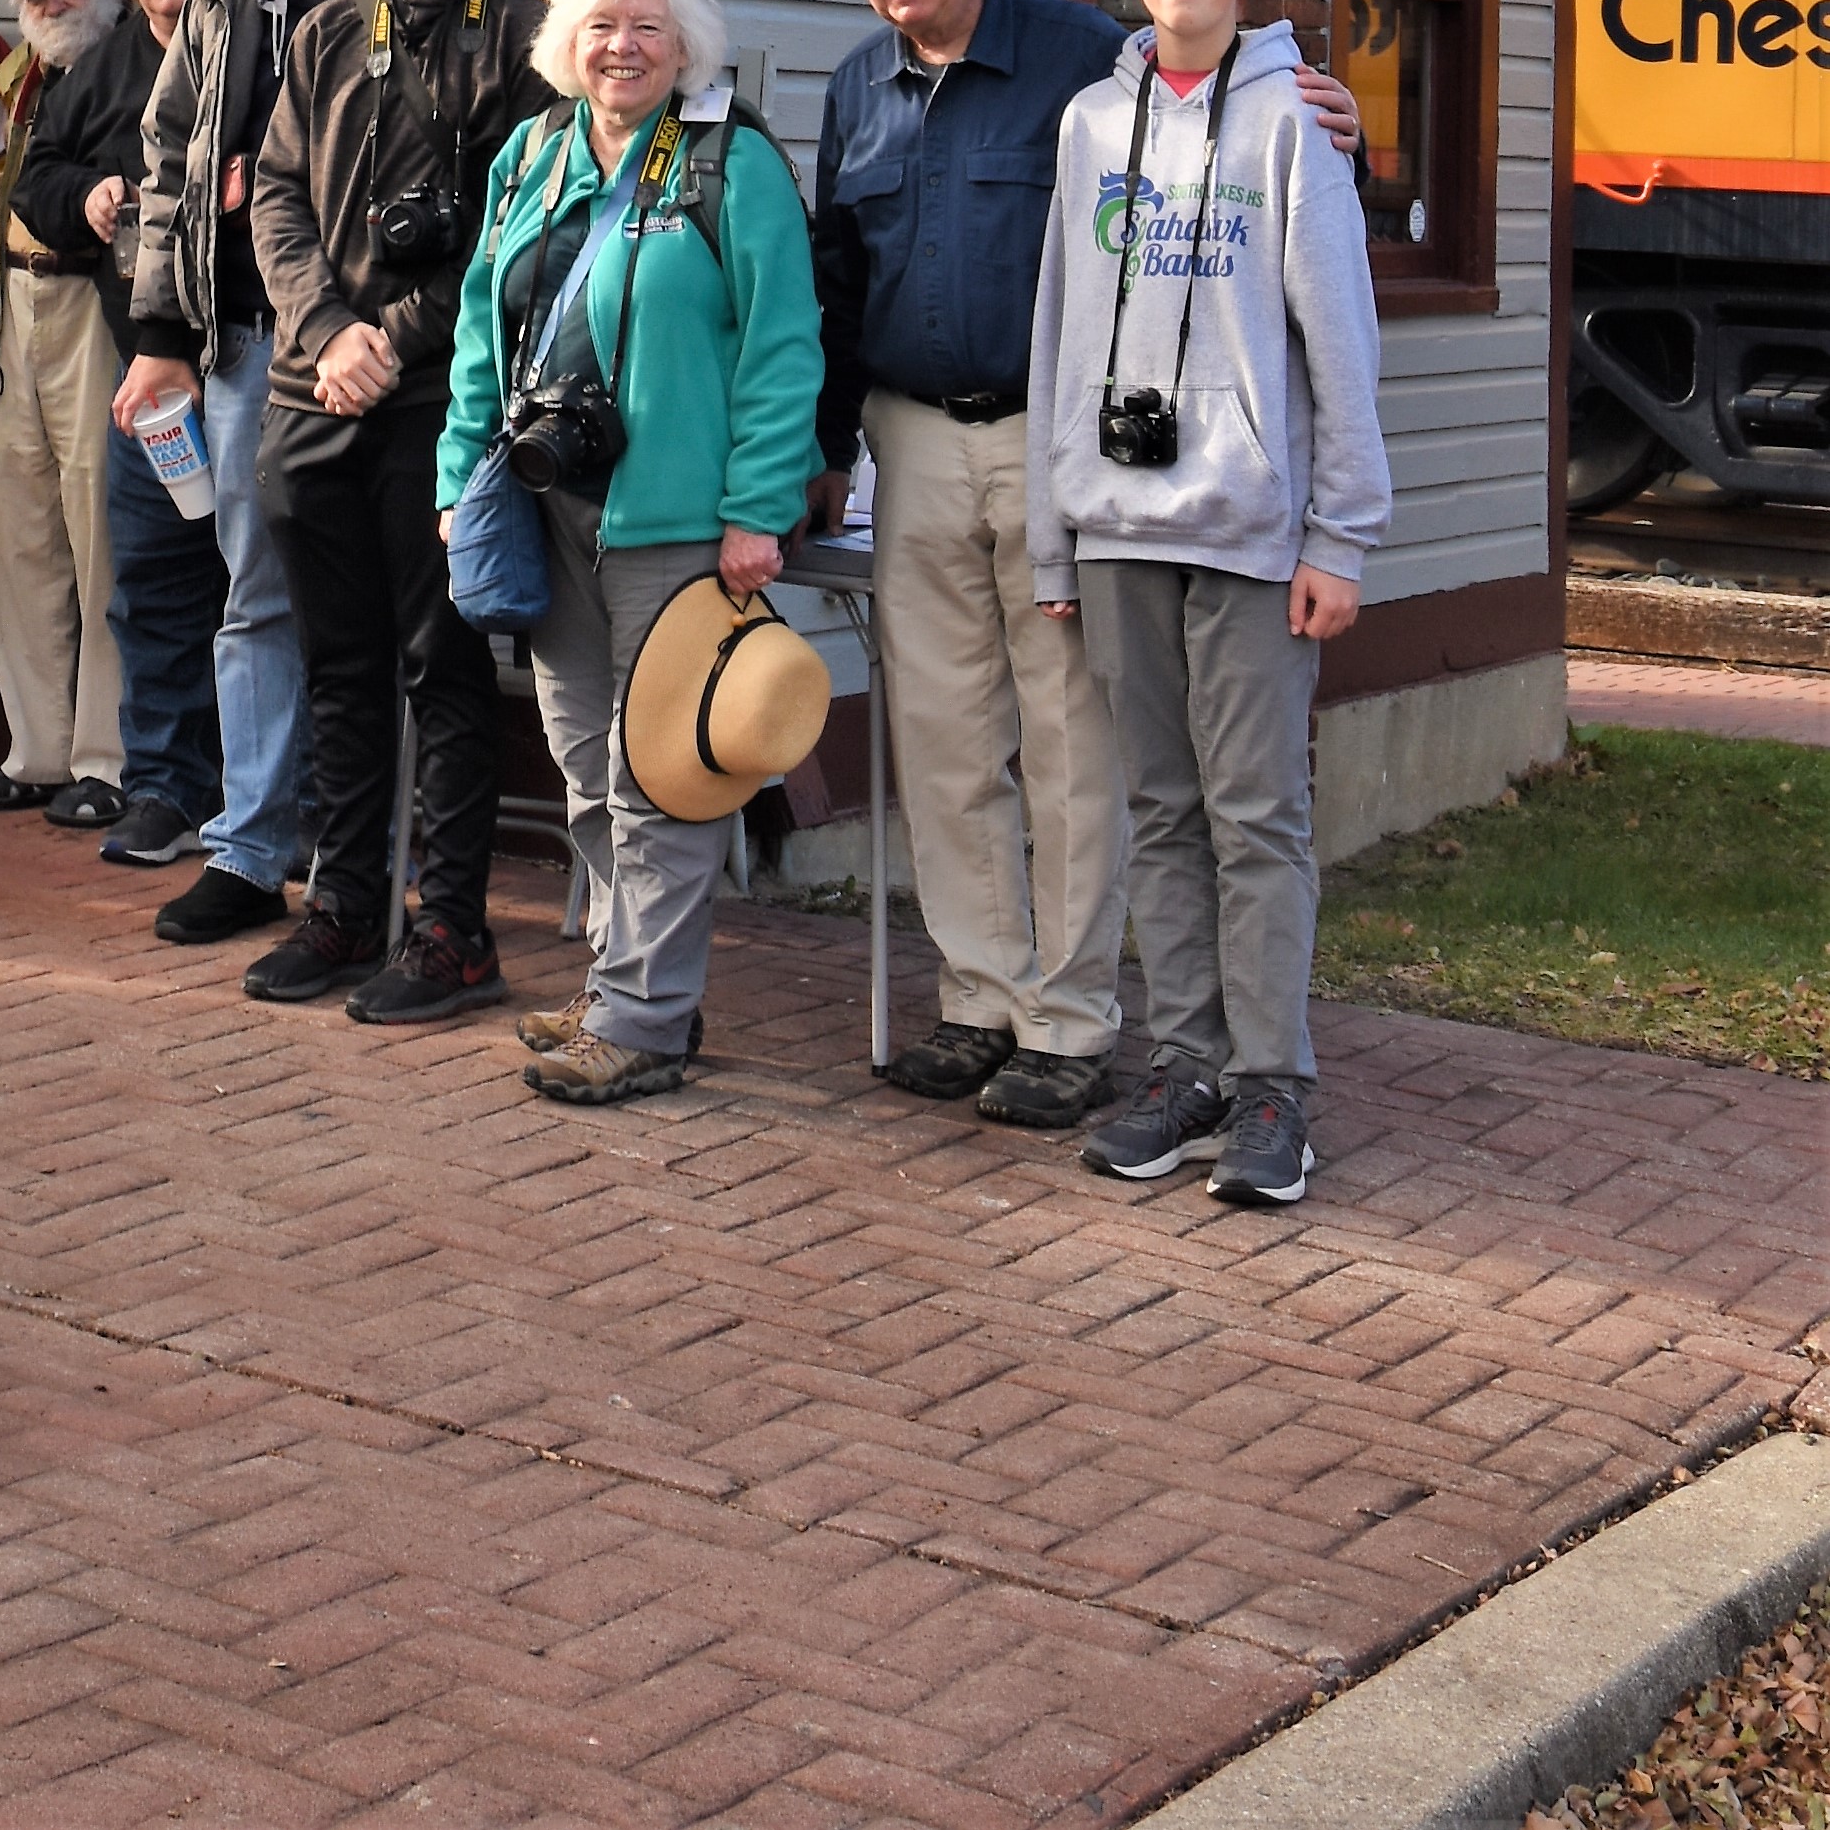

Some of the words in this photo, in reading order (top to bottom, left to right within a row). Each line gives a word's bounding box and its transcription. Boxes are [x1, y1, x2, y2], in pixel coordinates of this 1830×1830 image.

[374, 2, 389, 42] Nikon
[656, 116, 680, 151] D500
[1246, 189, 1265, 208] HS
[1142, 243, 1235, 277] Bands
[143, 426, 182, 445] YOUR
